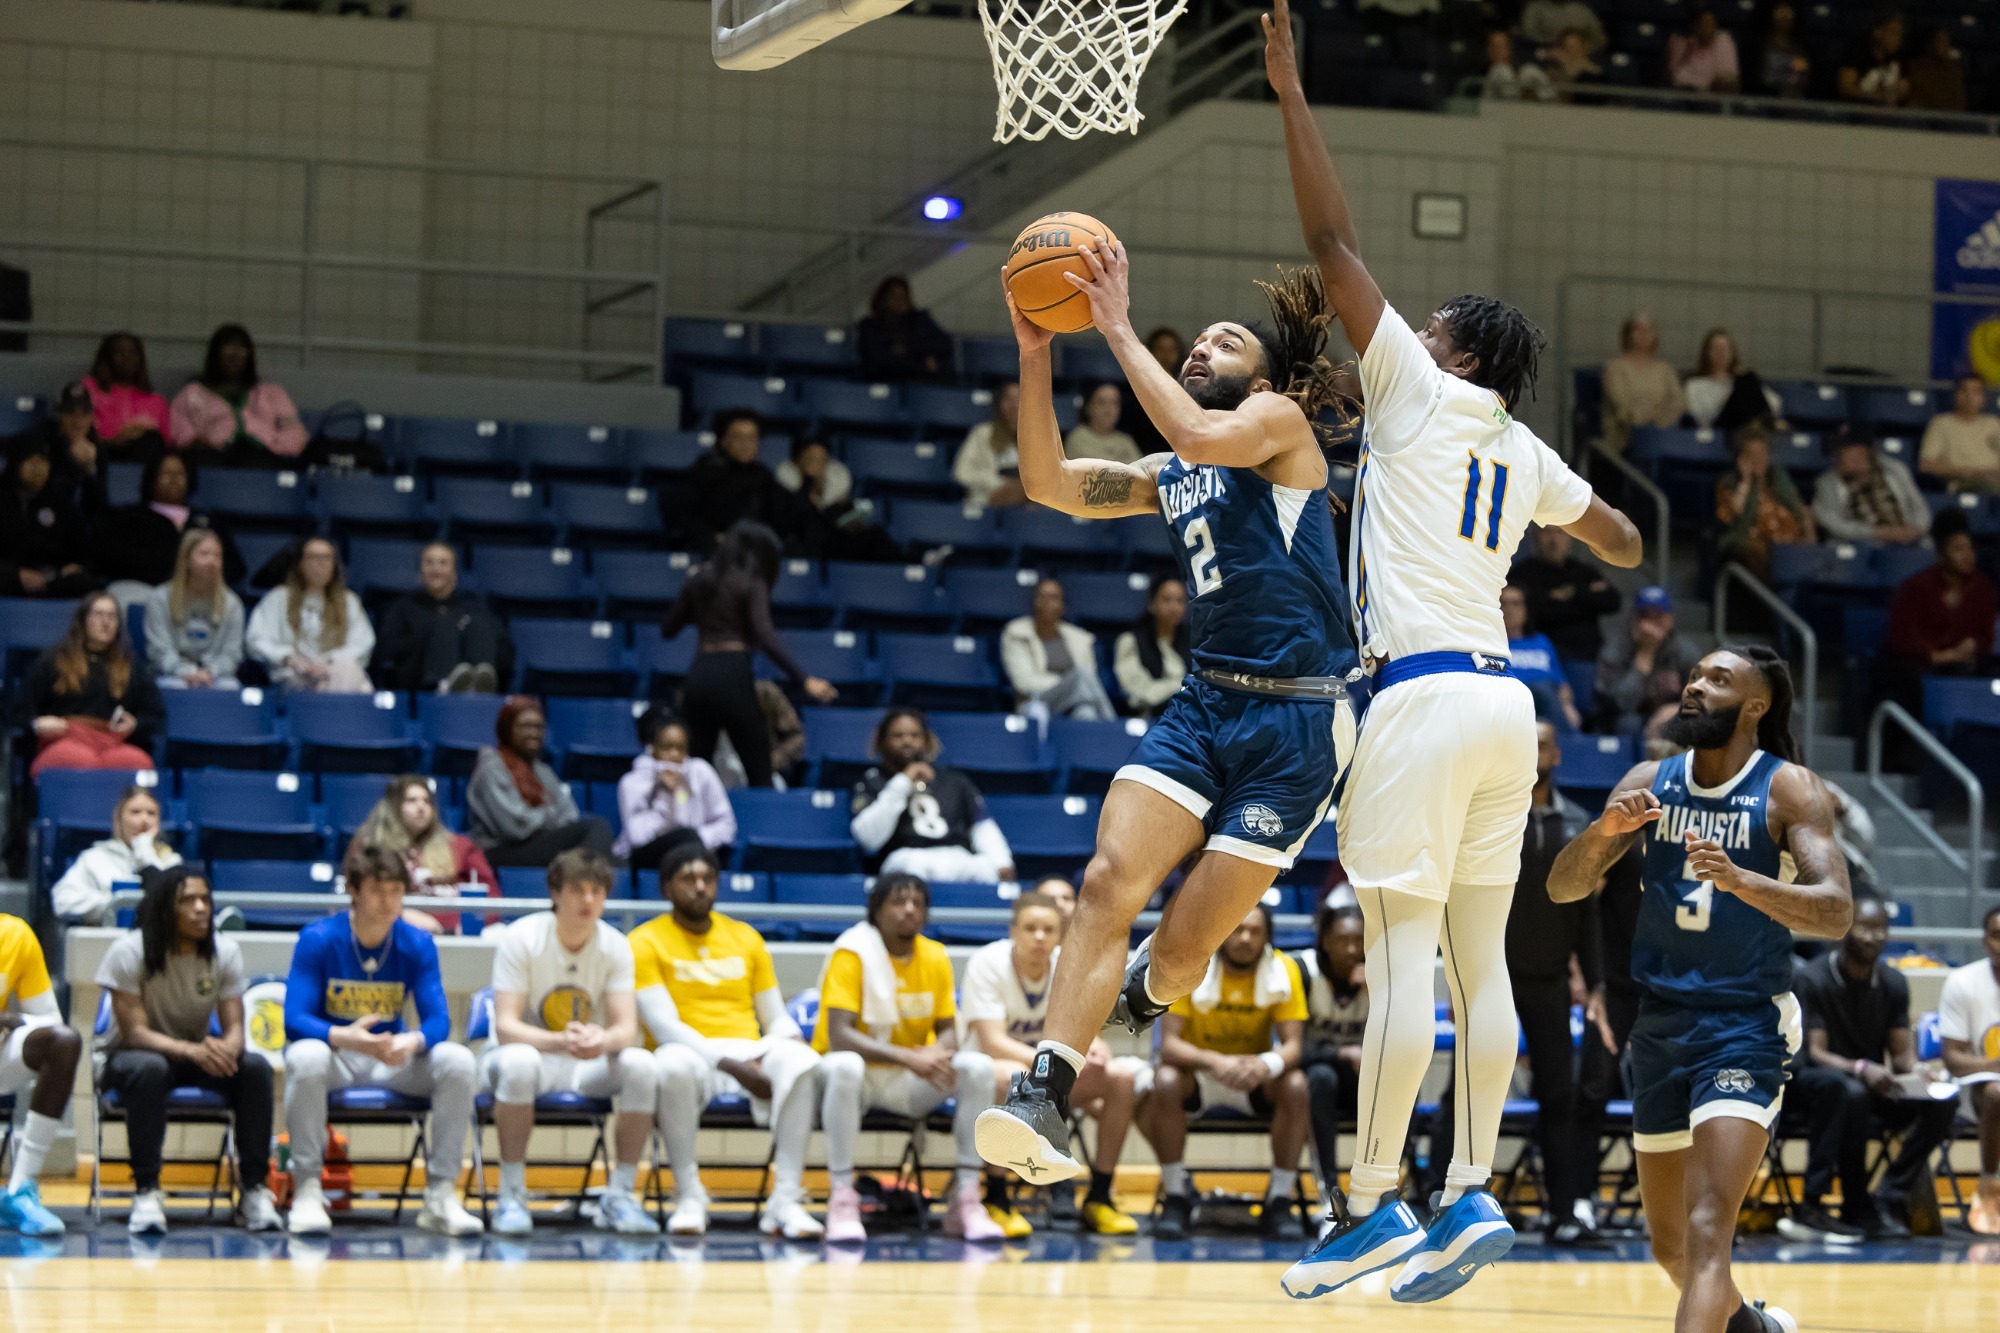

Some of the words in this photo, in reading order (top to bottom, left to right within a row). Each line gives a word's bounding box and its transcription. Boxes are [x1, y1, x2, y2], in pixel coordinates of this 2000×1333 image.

[1458, 448, 1511, 555] 11
[1184, 516, 1223, 598] 2
[908, 793, 949, 839] 8
[1655, 804, 1750, 849] AUGUSTA
[1675, 859, 1714, 932] 3
